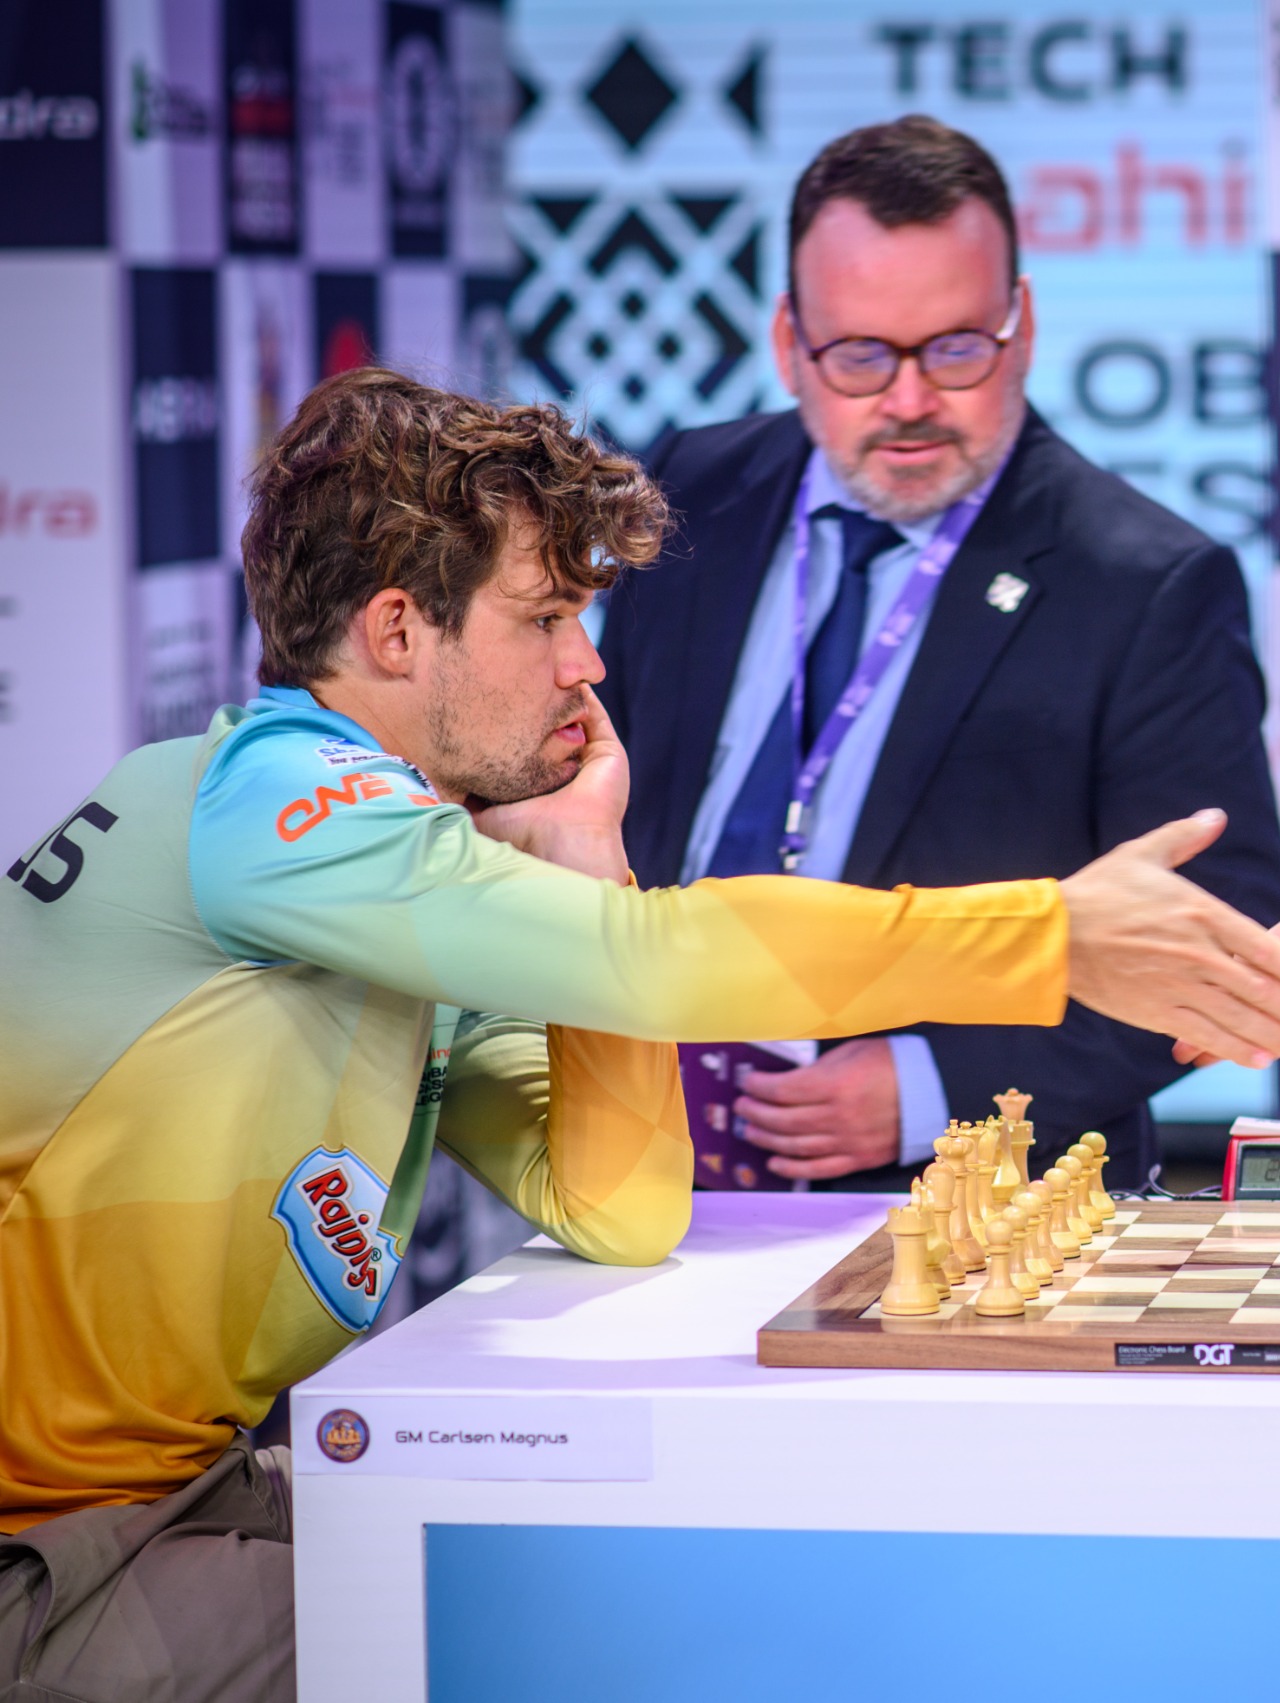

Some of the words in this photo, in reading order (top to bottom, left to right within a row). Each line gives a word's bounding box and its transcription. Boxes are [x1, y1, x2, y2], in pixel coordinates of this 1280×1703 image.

[876, 23, 1187, 101] TECH
[1194, 1344, 1234, 1365] DGT
[395, 1431, 422, 1444] GM
[429, 1430, 495, 1444] Carlsen
[500, 1431, 568, 1447] Magnus
